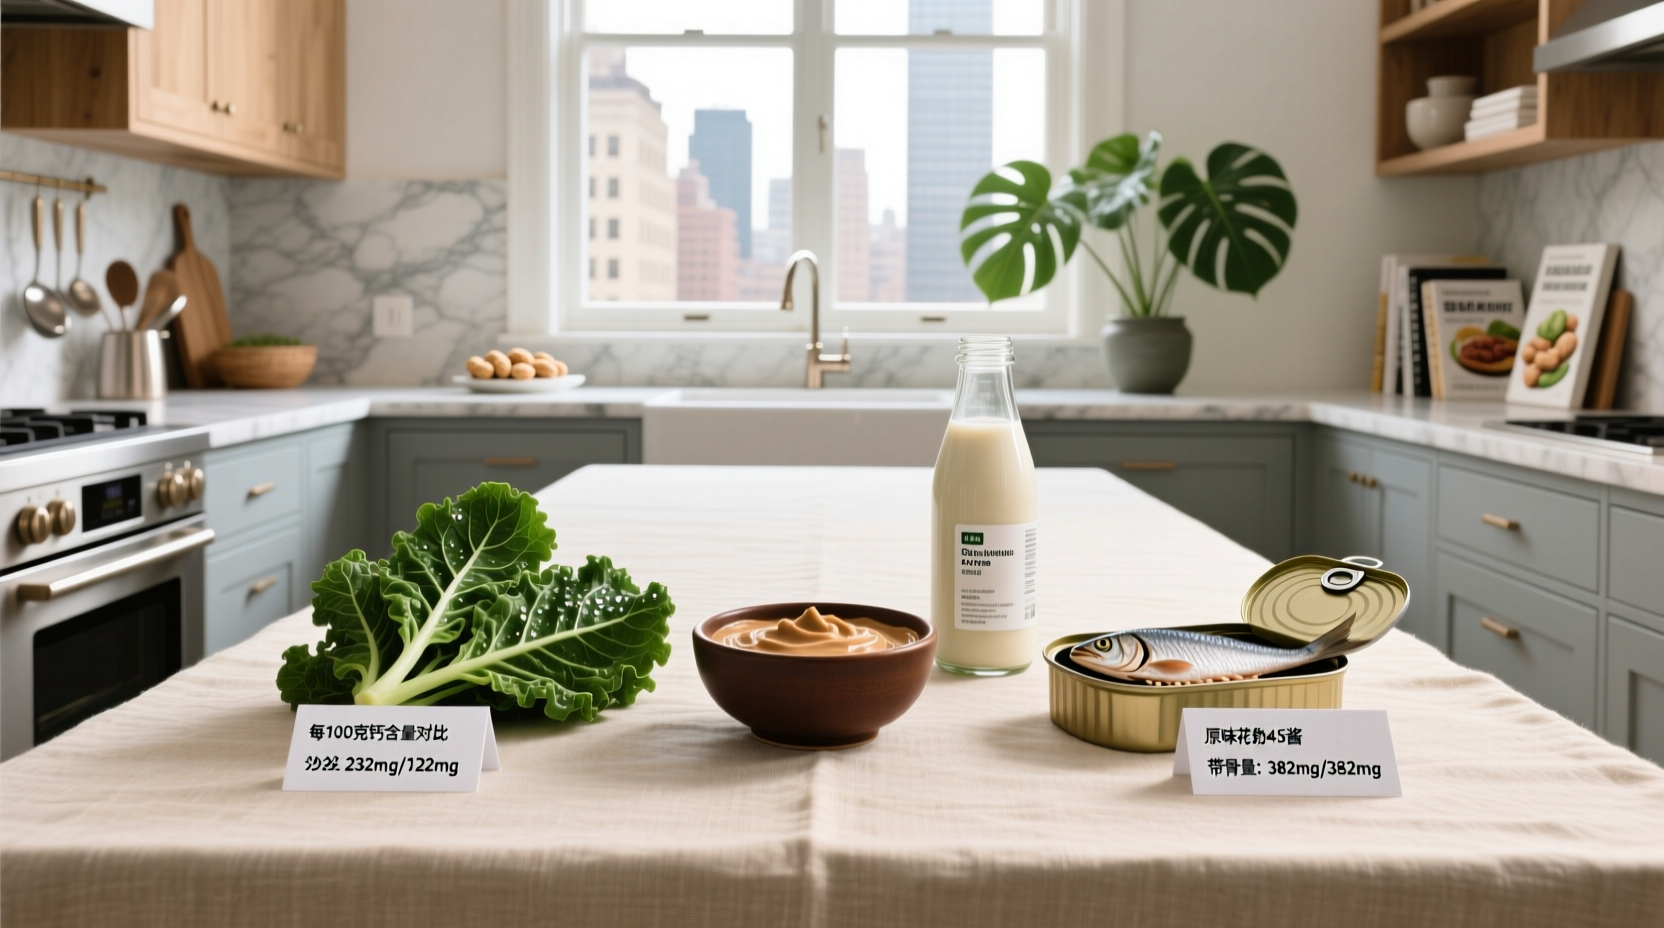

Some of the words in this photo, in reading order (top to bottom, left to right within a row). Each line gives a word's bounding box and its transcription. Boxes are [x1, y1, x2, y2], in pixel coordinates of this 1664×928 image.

[309, 723, 448, 741] 每100克钙含量对比
[344, 756, 459, 777] 232mg/122mg
[1267, 759, 1382, 779] 382mg/382mg
